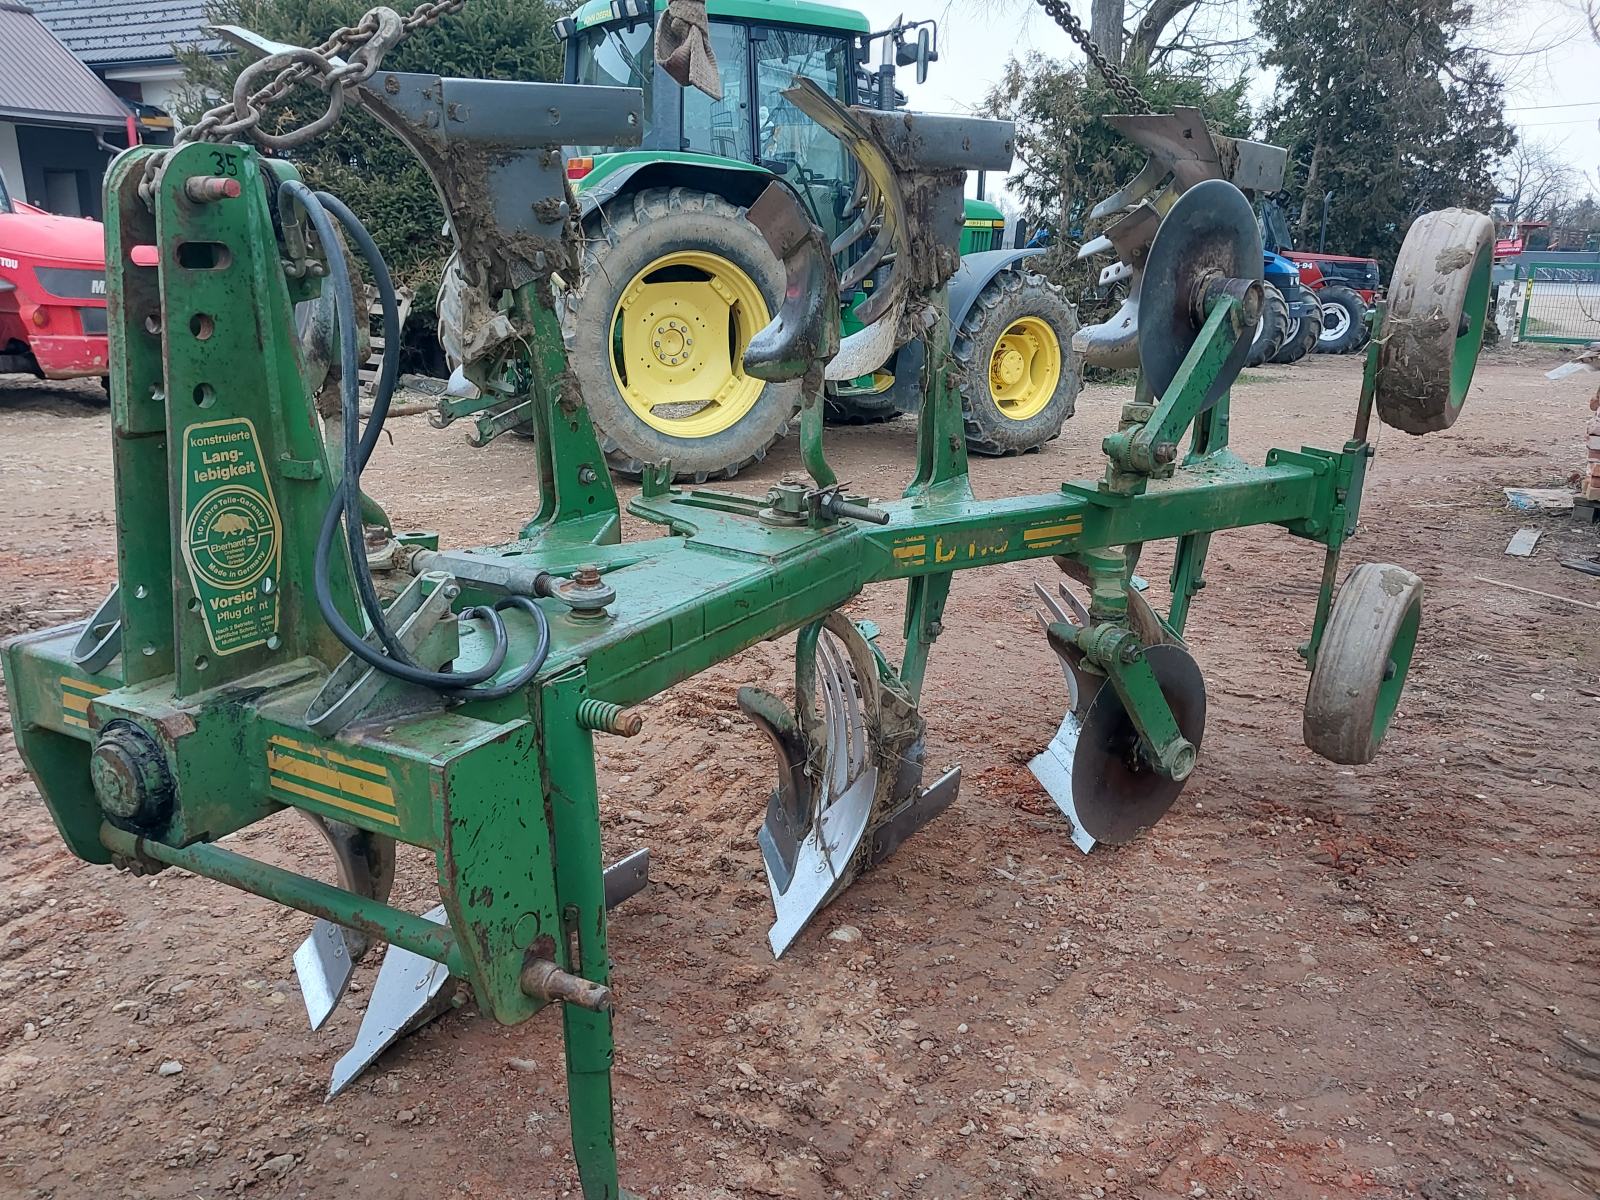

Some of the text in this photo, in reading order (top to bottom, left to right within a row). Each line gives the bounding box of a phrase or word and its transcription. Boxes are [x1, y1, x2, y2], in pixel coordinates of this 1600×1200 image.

[209, 151, 238, 176] 35
[91, 280, 107, 294] M
[190, 430, 250, 447] konstruierte
[202, 450, 244, 465] Lang-
[194, 461, 256, 483] lebigkeit
[196, 496, 265, 536] 10 Jahre Teile-Garantie
[210, 538, 247, 553] Eberhardt
[207, 562, 228, 578] Made
[229, 570, 237, 578] in
[237, 550, 266, 577] Germany
[217, 609, 242, 623] Pflug
